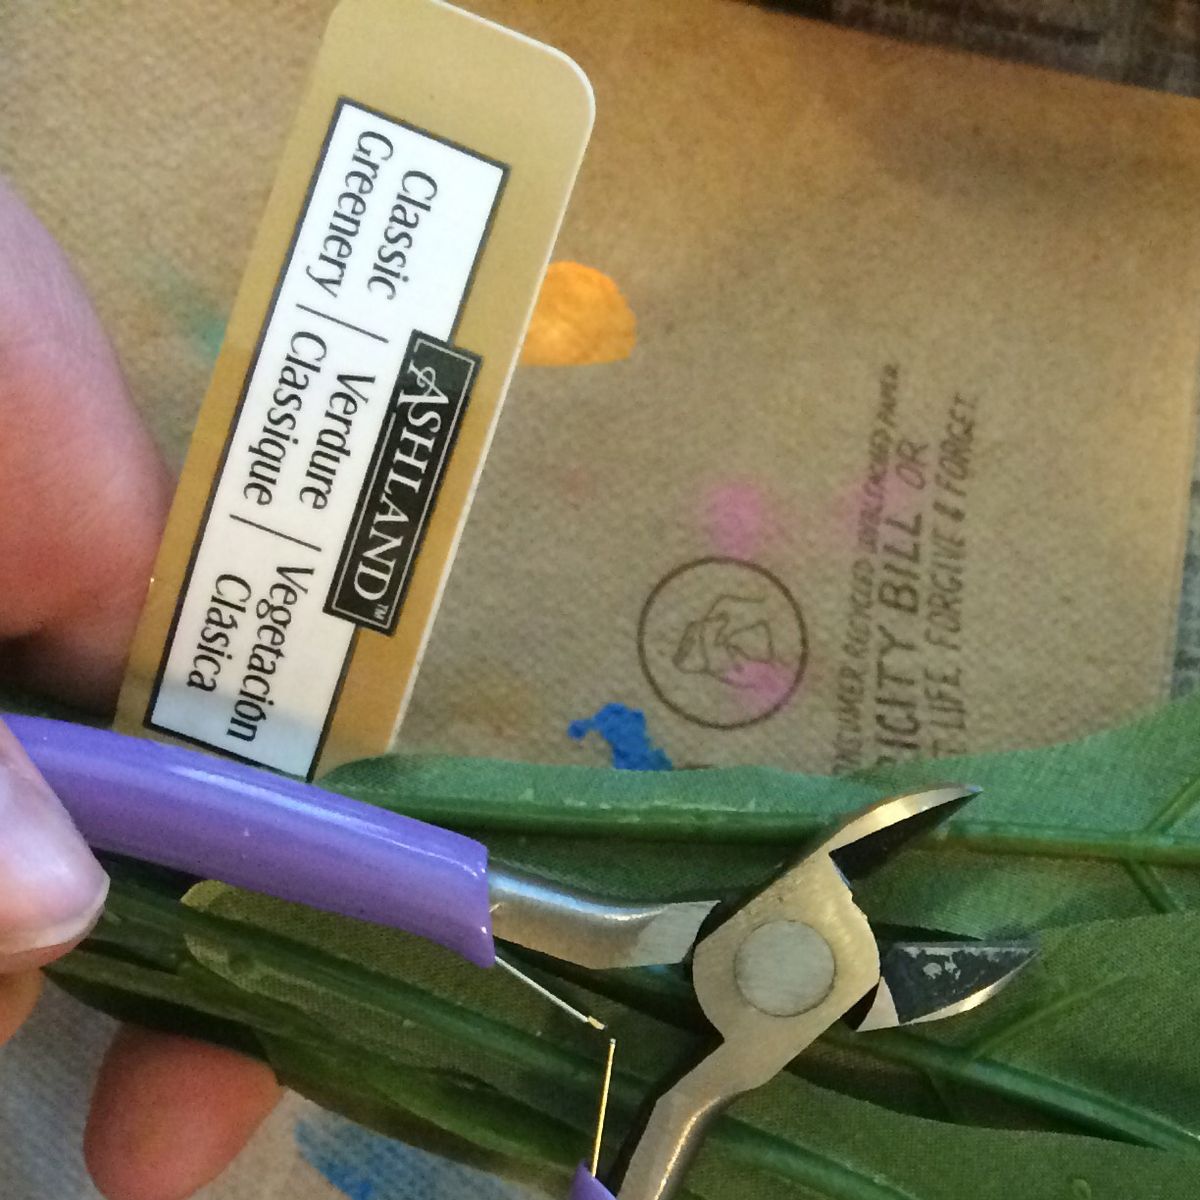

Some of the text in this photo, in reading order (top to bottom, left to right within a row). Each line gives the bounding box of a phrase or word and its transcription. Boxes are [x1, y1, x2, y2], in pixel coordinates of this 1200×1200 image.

[305, 130, 394, 299] Greenery
[367, 169, 438, 300] Classic
[242, 331, 328, 506] Classique
[301, 372, 377, 511] Verdure
[352, 360, 443, 600] ASHLAND
[896, 438, 930, 490] OR
[879, 513, 922, 613] BILL
[924, 527, 967, 652] FORGIVE
[185, 574, 252, 694] Clásica
[226, 566, 316, 743] Vegetación
